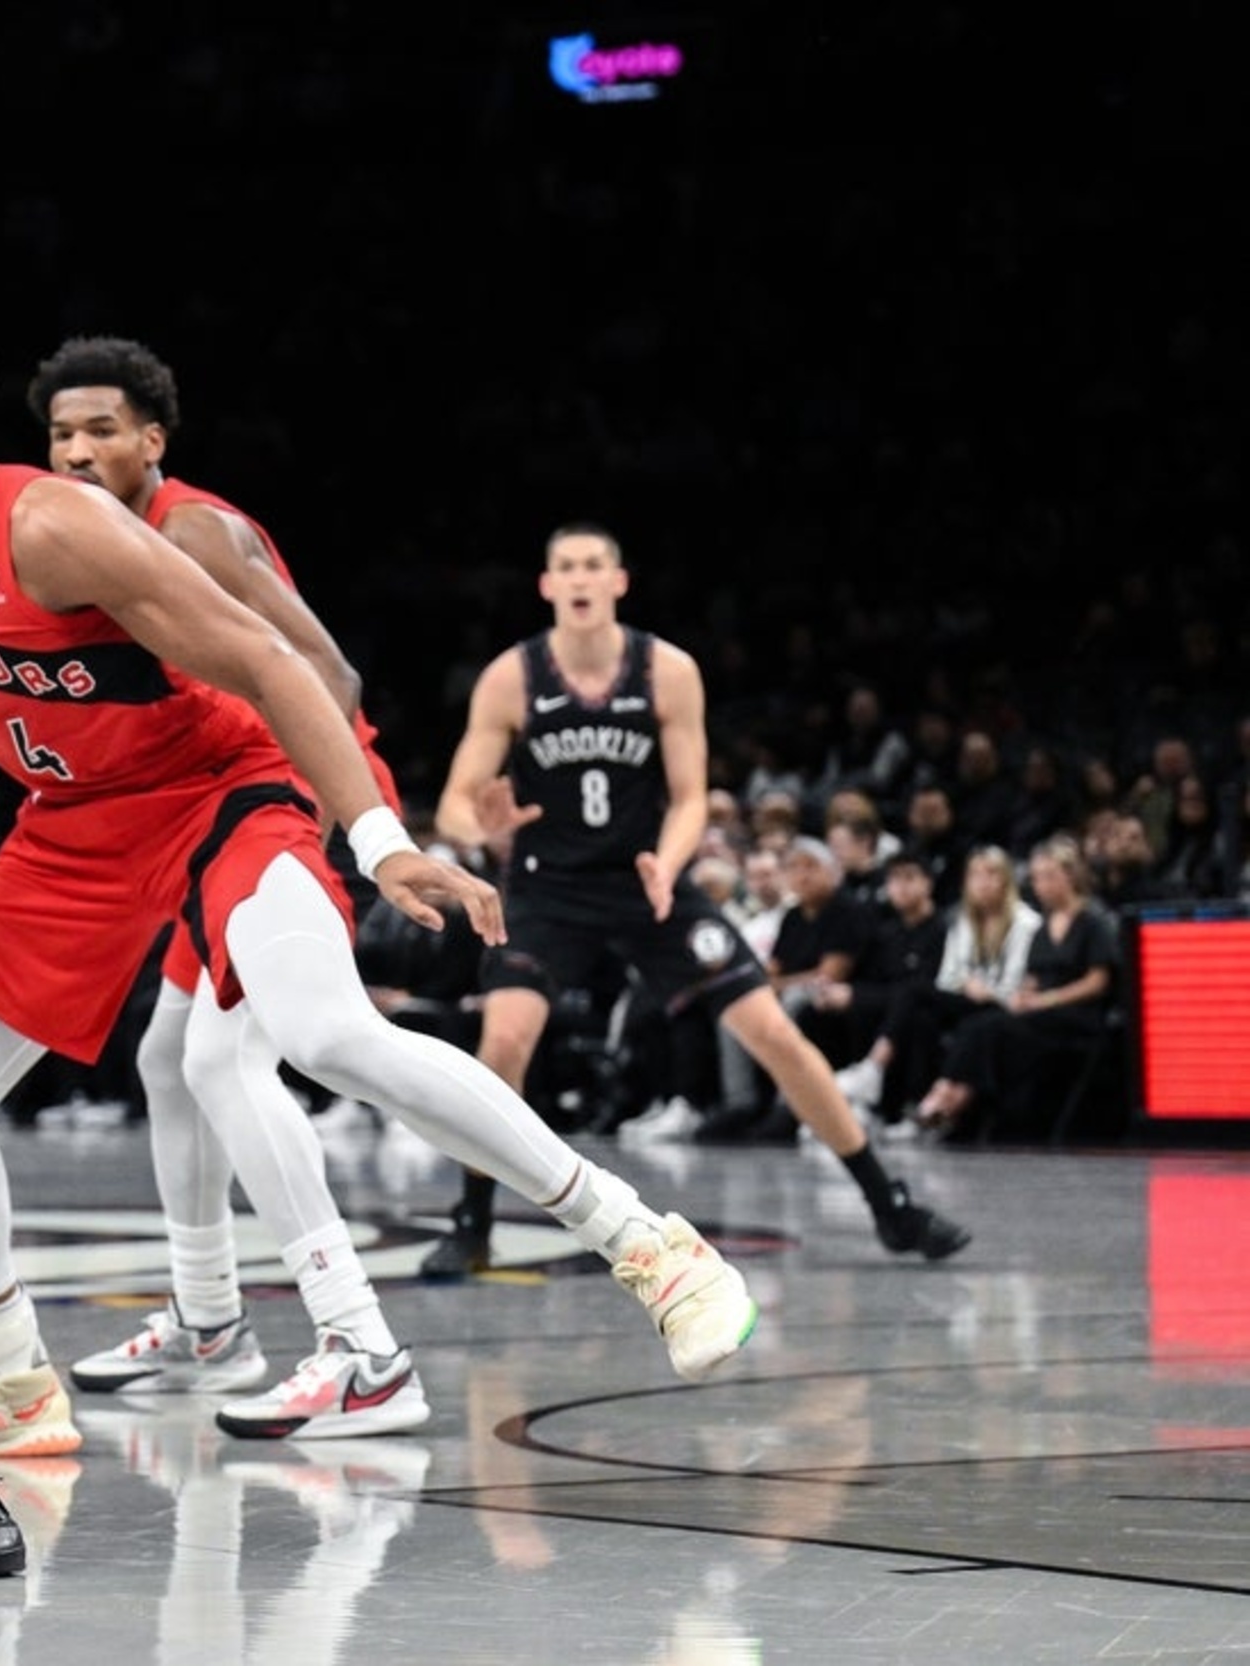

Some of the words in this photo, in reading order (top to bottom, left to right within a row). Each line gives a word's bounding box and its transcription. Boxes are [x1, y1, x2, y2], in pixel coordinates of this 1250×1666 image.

[6, 717, 74, 781] 4
[530, 725, 653, 769] BROOKLYN
[581, 769, 610, 827] 8
